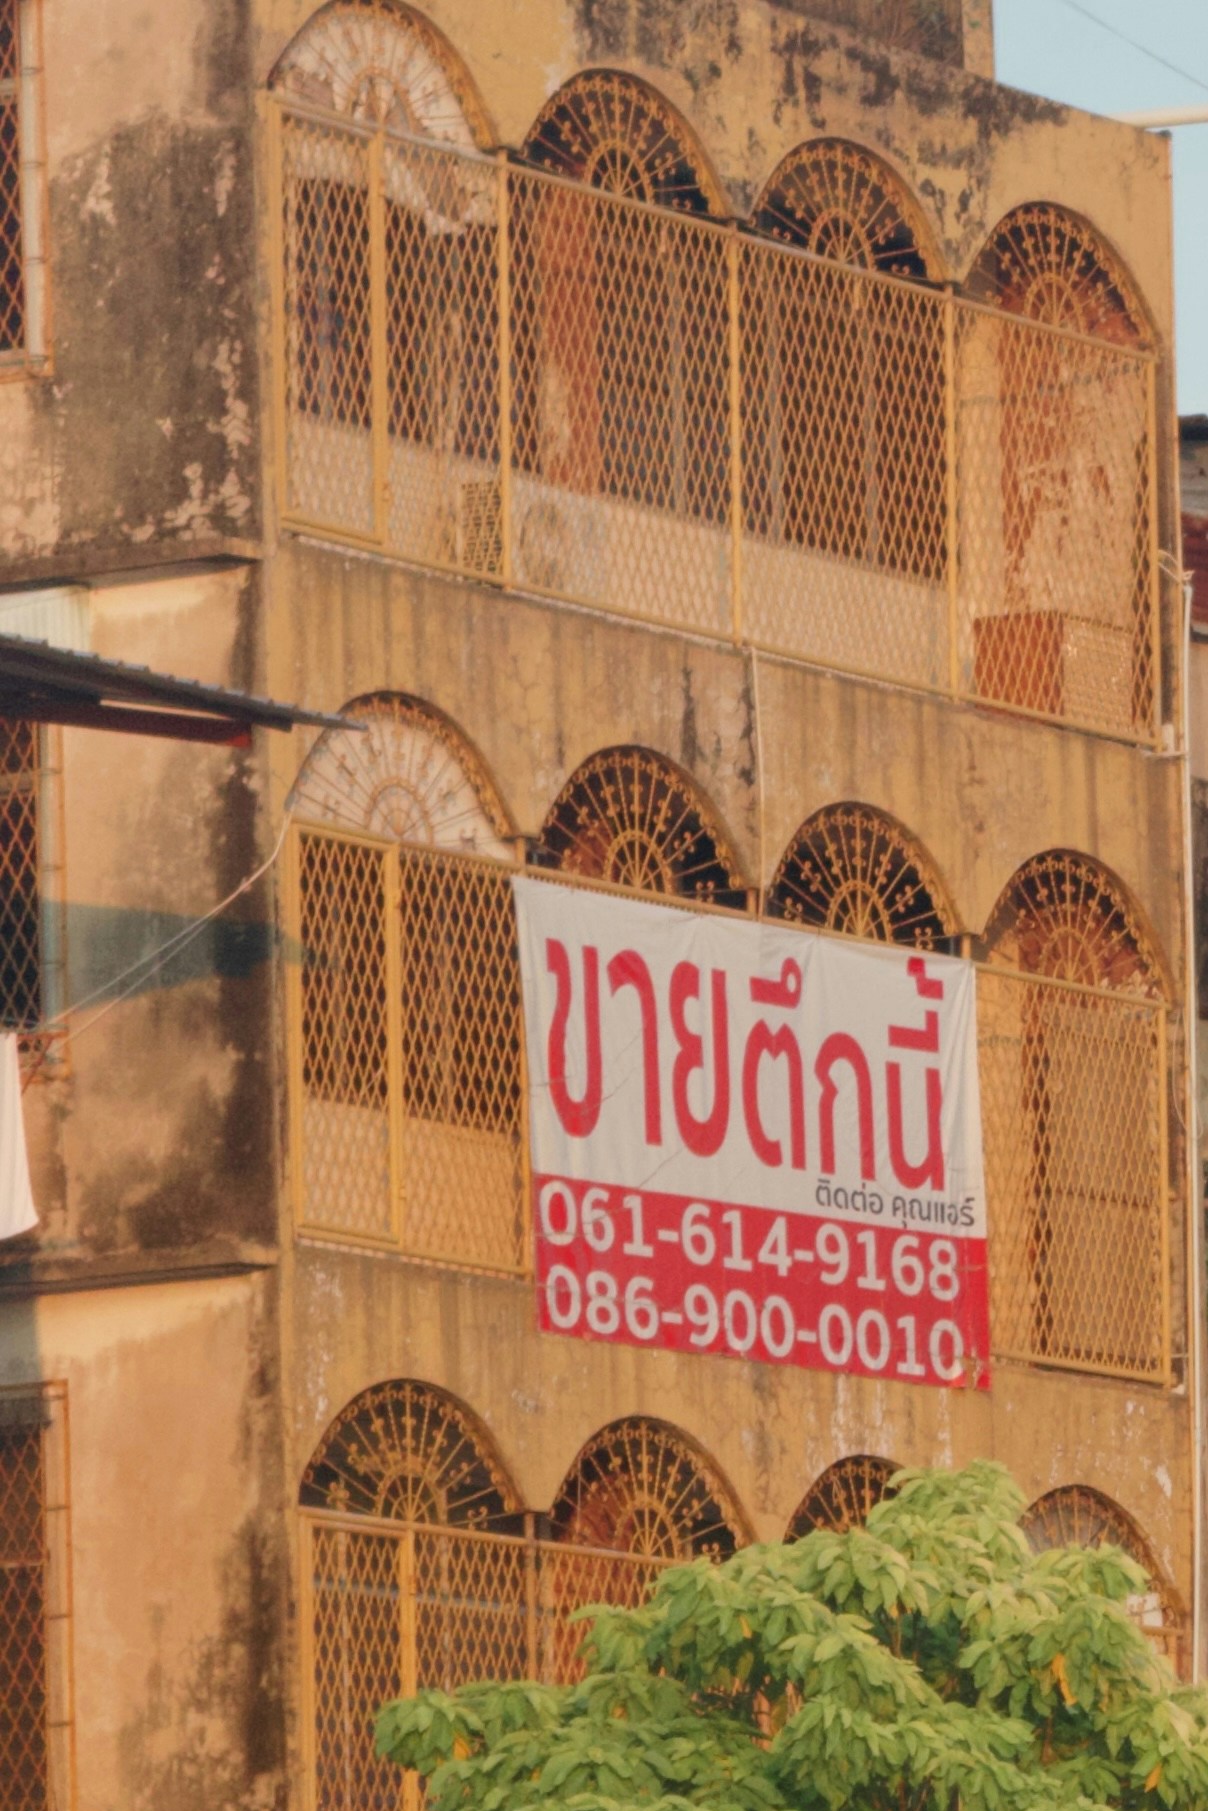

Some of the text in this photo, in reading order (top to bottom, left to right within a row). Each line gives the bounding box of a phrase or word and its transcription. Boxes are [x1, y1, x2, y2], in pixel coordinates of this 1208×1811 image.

[546, 938, 944, 1190] ขายตึกนี้
[540, 1183, 960, 1302] 061-614-9168
[815, 1179, 975, 1229] ติดต่อ คุณแอร์
[546, 1265, 964, 1380] 086-900-0010
